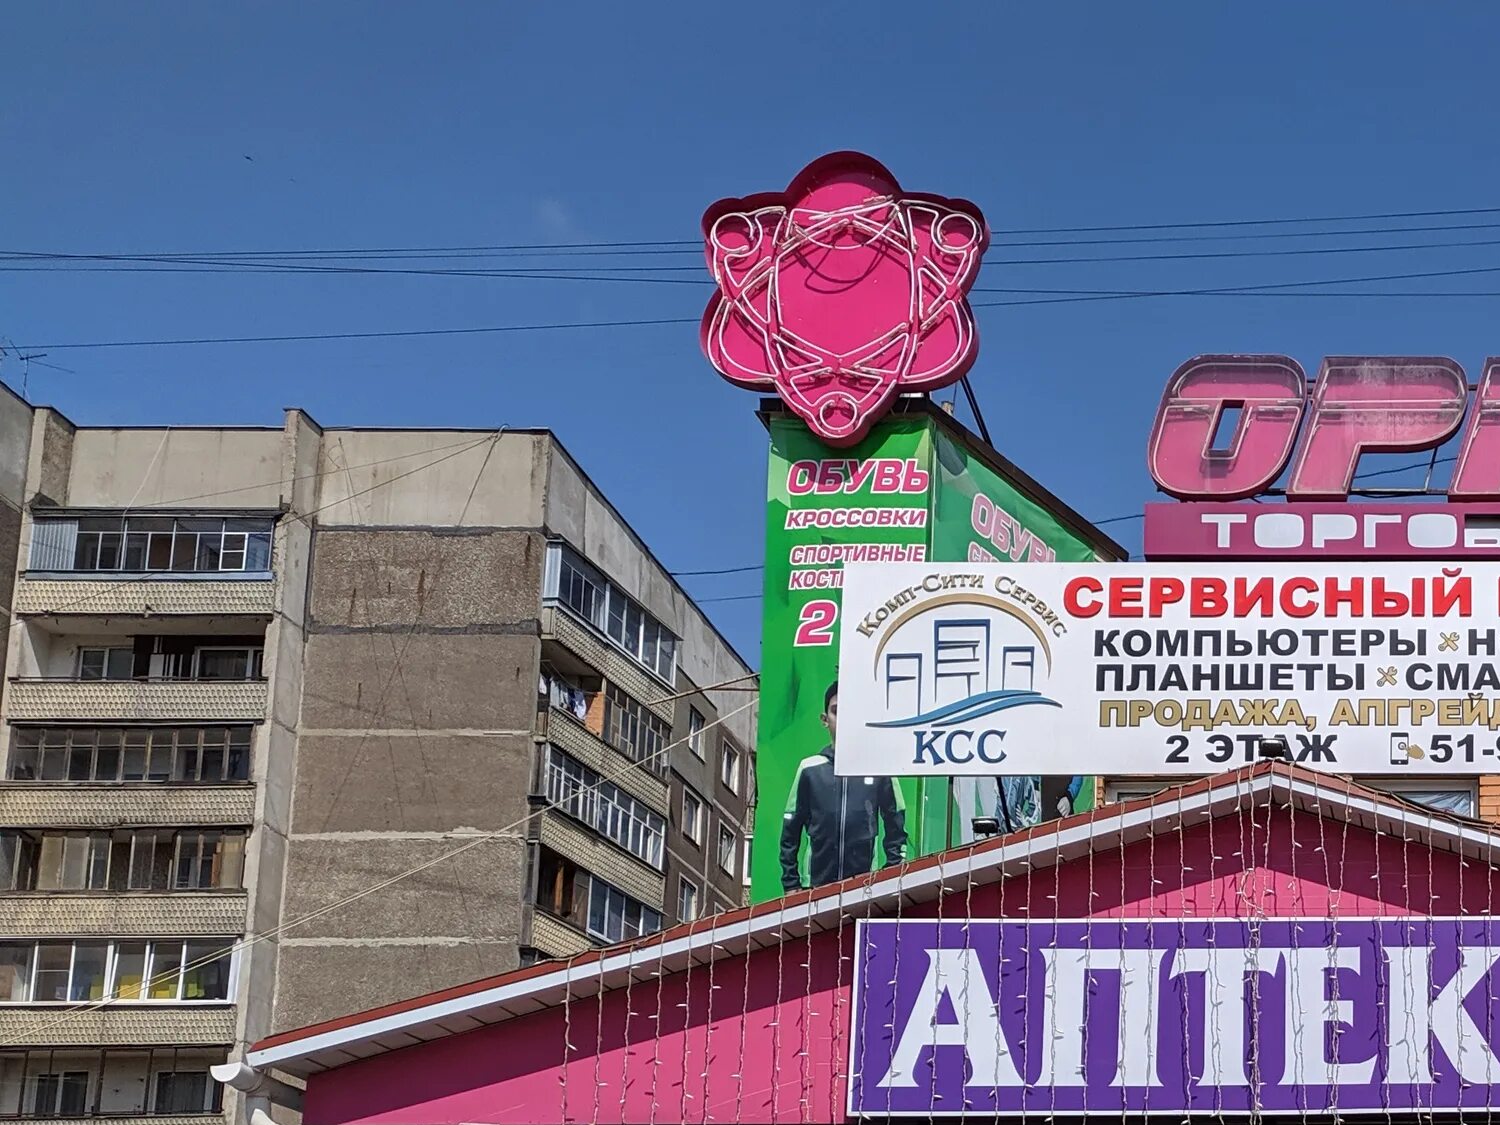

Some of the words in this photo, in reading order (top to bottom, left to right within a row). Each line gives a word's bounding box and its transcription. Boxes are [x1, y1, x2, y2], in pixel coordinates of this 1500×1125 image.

[786, 459, 929, 495] ОБУВЬ
[784, 508, 928, 529] КРОССОВКИ
[789, 544, 926, 565] СПОРТИВНЫЕ
[788, 569, 844, 590] КОСТ
[1063, 568, 1472, 618] СЕРВИСНЫЙ
[793, 600, 838, 647] 2
[1093, 628, 1427, 658] КОМПЬЮТЕРЫ
[1096, 663, 1366, 692] ПЛАНШЕТЫ
[1098, 698, 1317, 731] ПРОДАЖА,
[1165, 735, 1190, 763] 2
